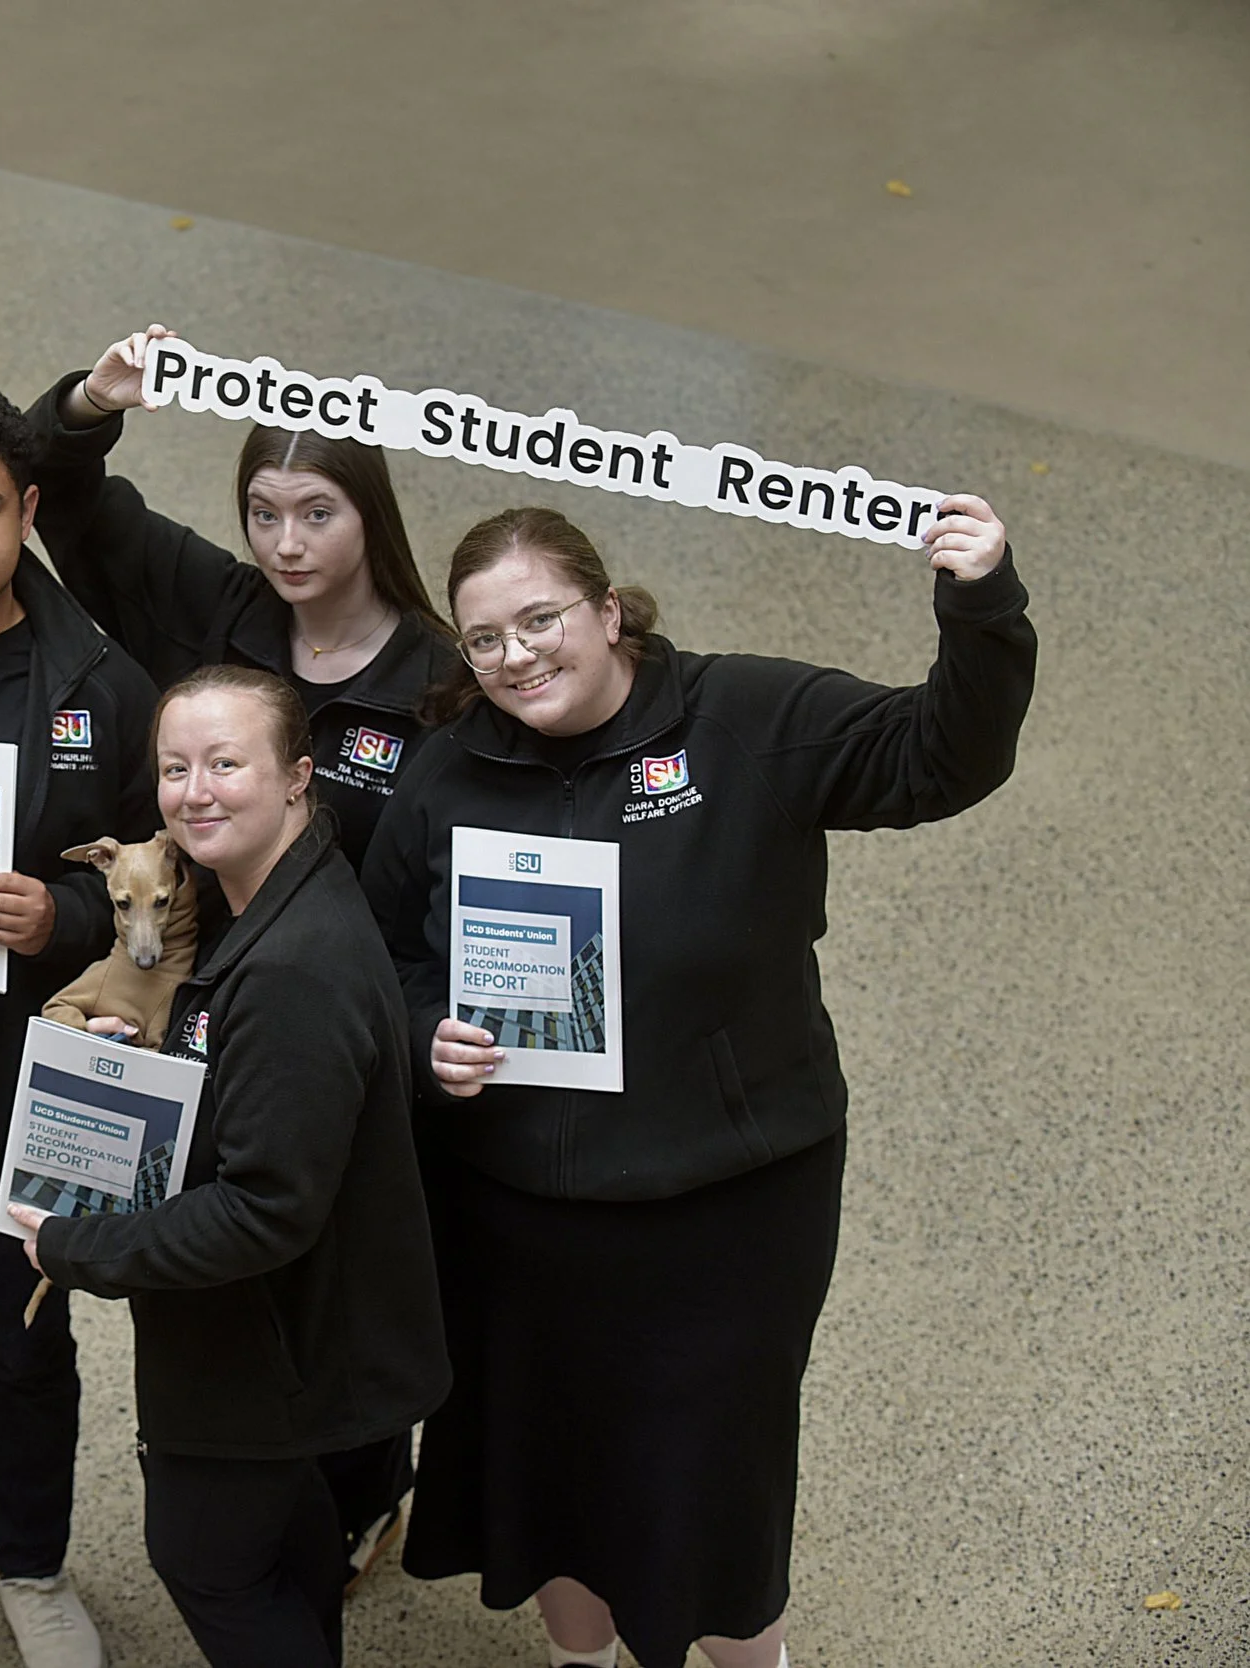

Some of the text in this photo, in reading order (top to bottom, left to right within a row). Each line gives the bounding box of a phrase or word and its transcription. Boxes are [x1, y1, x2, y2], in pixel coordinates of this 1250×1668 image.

[153, 349, 378, 433] Protect
[422, 401, 673, 489] Student
[52, 716, 85, 741] SU
[339, 727, 397, 764] UCD SU
[337, 763, 351, 774] TIA
[631, 757, 685, 794] UCD SU
[622, 794, 702, 823] WELFARE OFFICER
[625, 801, 654, 812] CIARA
[517, 855, 539, 871] SU
[466, 925, 553, 941] UCD Students' Union
[463, 944, 510, 957] STUDENT
[463, 958, 565, 976] ACCOMMODATION
[463, 971, 527, 990] REPORT
[180, 1014, 197, 1043] UCD
[97, 1061, 122, 1077] SU
[29, 1121, 79, 1141] STUDENT
[34, 1106, 126, 1137] UCD Students' Union
[25, 1143, 93, 1170] REPORT
[27, 1132, 133, 1167] ACCOMMODATION
